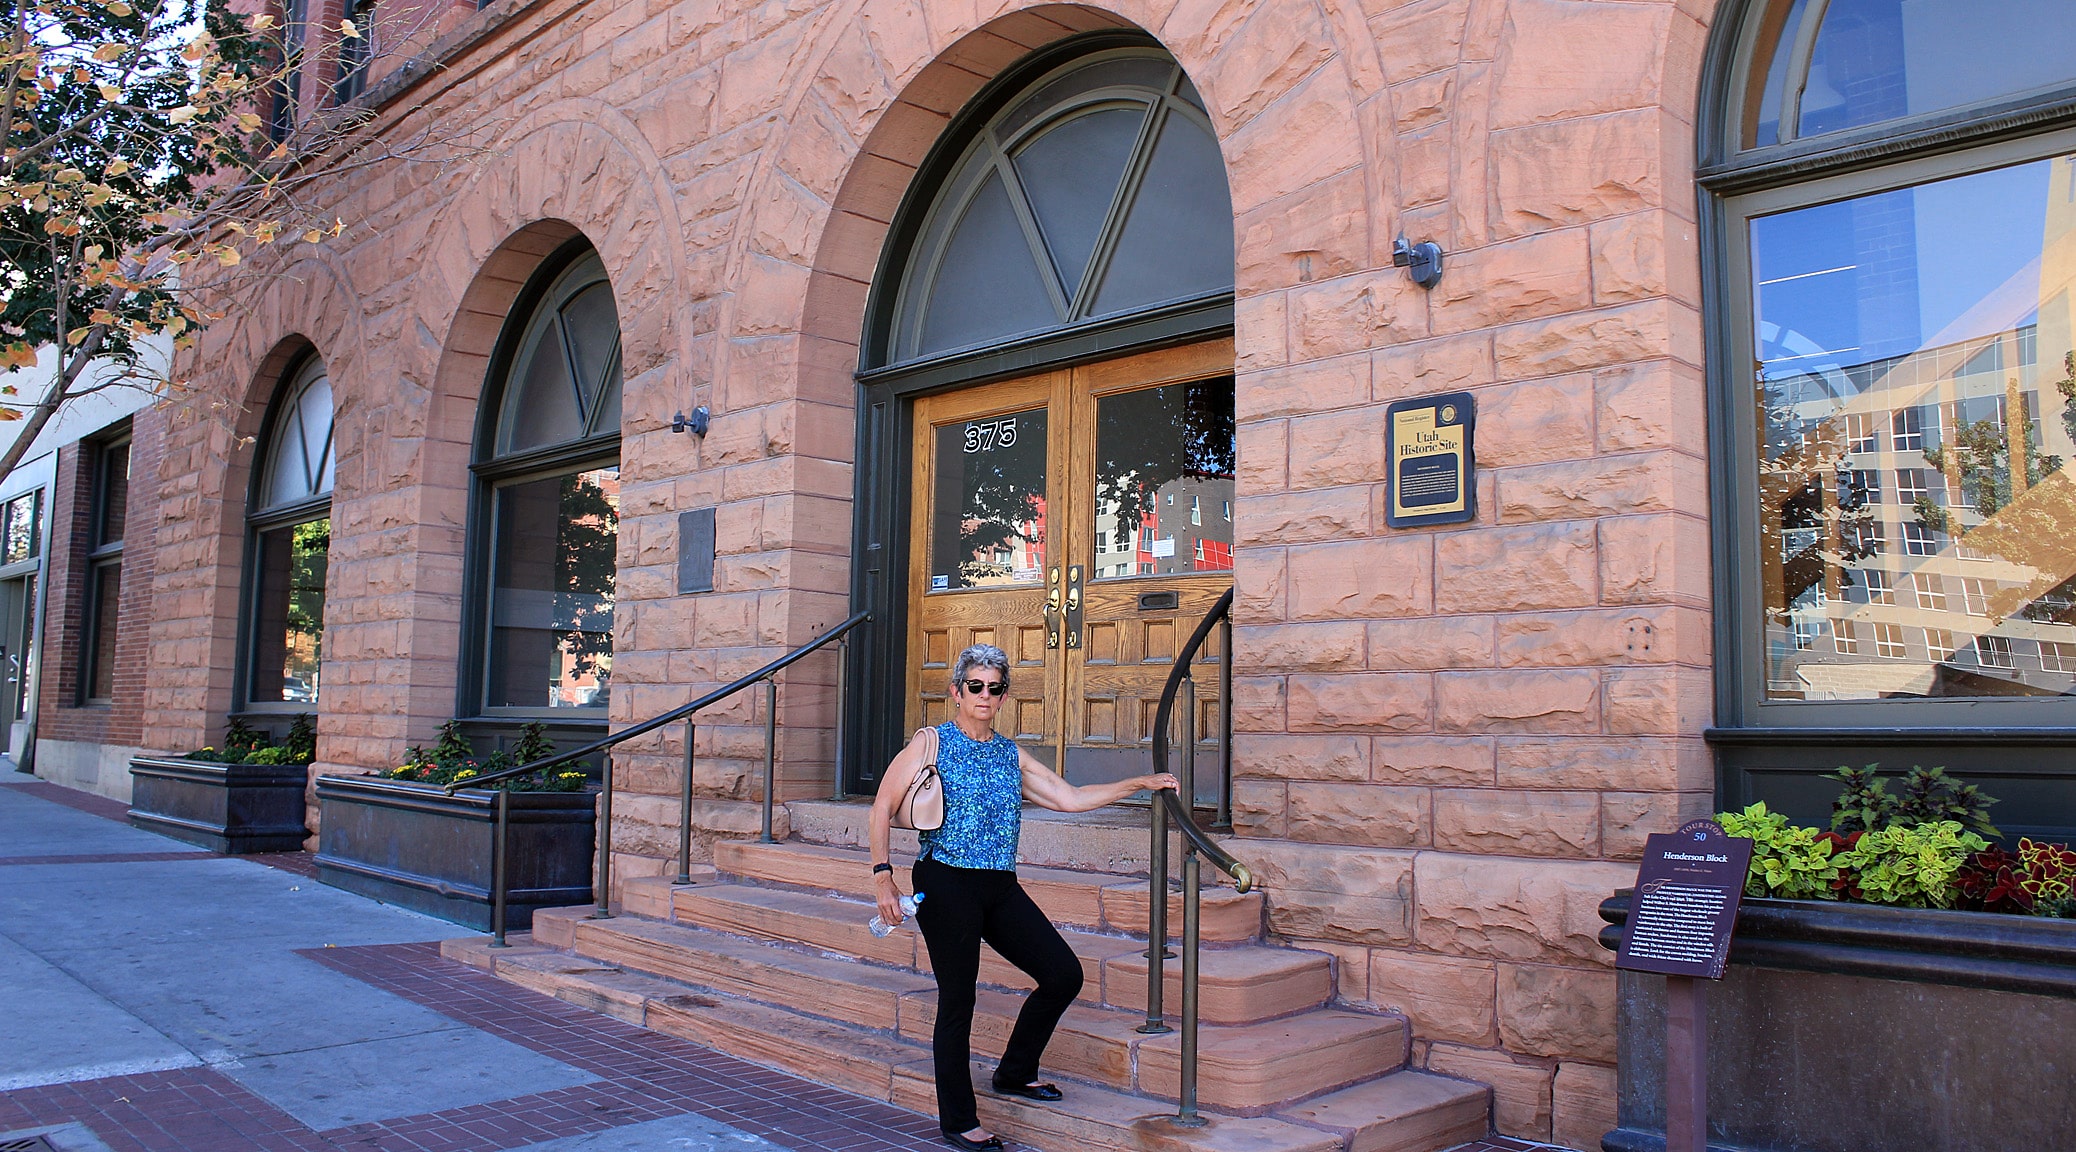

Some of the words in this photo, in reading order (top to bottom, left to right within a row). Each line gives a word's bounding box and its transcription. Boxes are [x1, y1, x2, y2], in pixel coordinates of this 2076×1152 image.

[963, 418, 1017, 453] 375
[1416, 430, 1439, 443] Utah
[1400, 442, 1437, 456] Historic
[1439, 439, 1457, 451] Site
[1681, 822, 1704, 834] TOUR
[1705, 823, 1722, 836] STOP
[1693, 832, 1707, 841] 50
[1663, 852, 1705, 861] Henderson
[1705, 854, 1728, 863] Block
